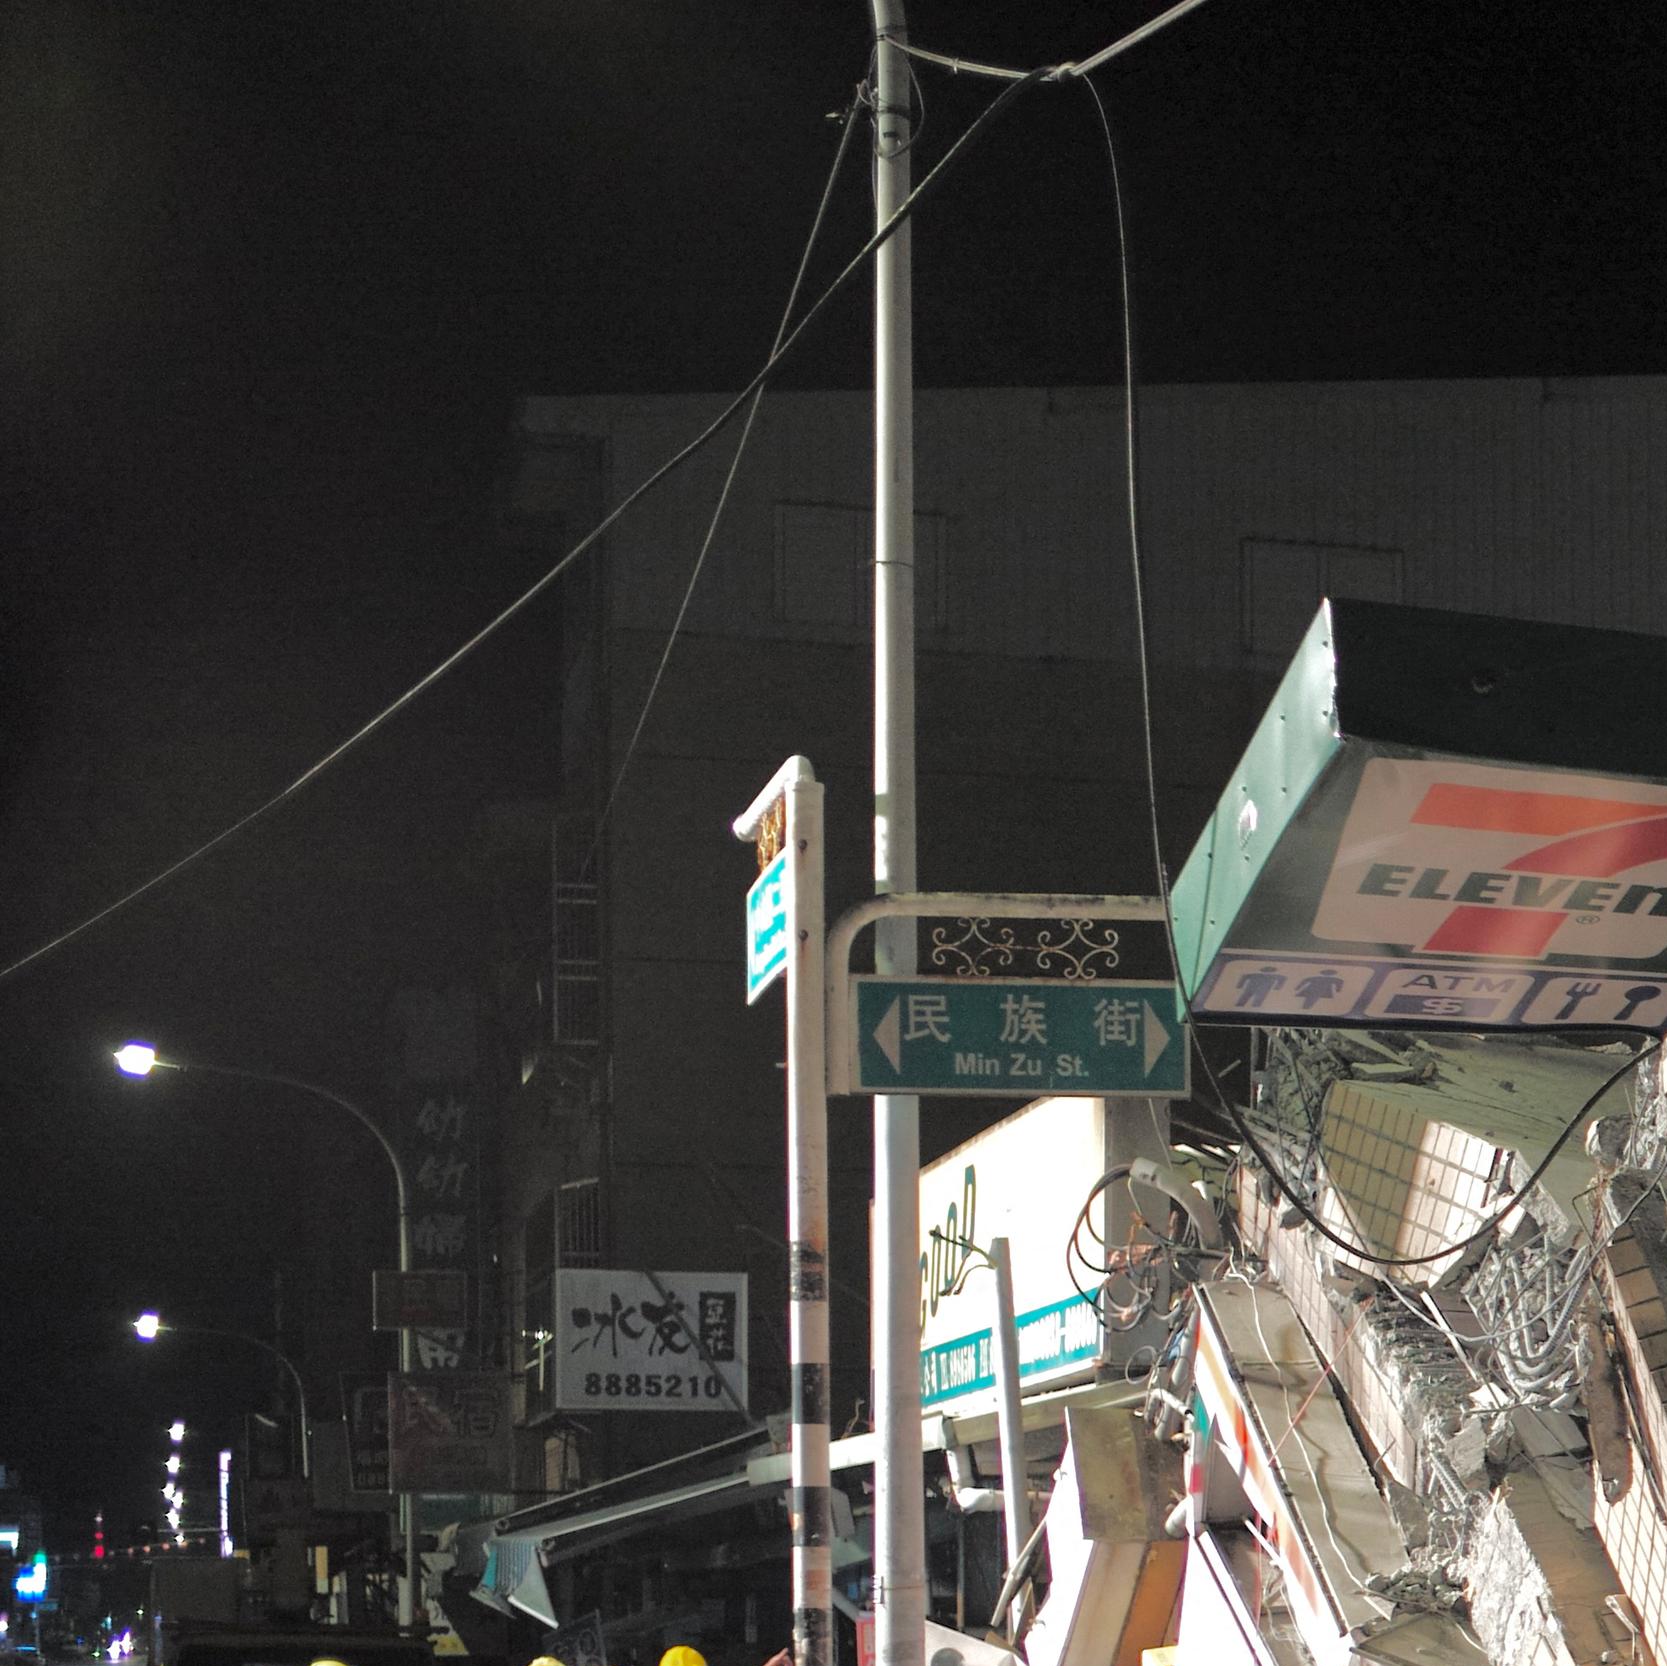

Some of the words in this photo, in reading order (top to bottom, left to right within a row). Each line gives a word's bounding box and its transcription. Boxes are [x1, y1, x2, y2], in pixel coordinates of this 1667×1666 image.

[1402, 973, 1514, 995] ATM
[904, 994, 1141, 1047] 民族街
[954, 1053, 1000, 1076] Min
[1010, 1053, 1042, 1076] Zu
[1056, 1053, 1089, 1077] St.
[584, 1373, 723, 1398] 8885210
